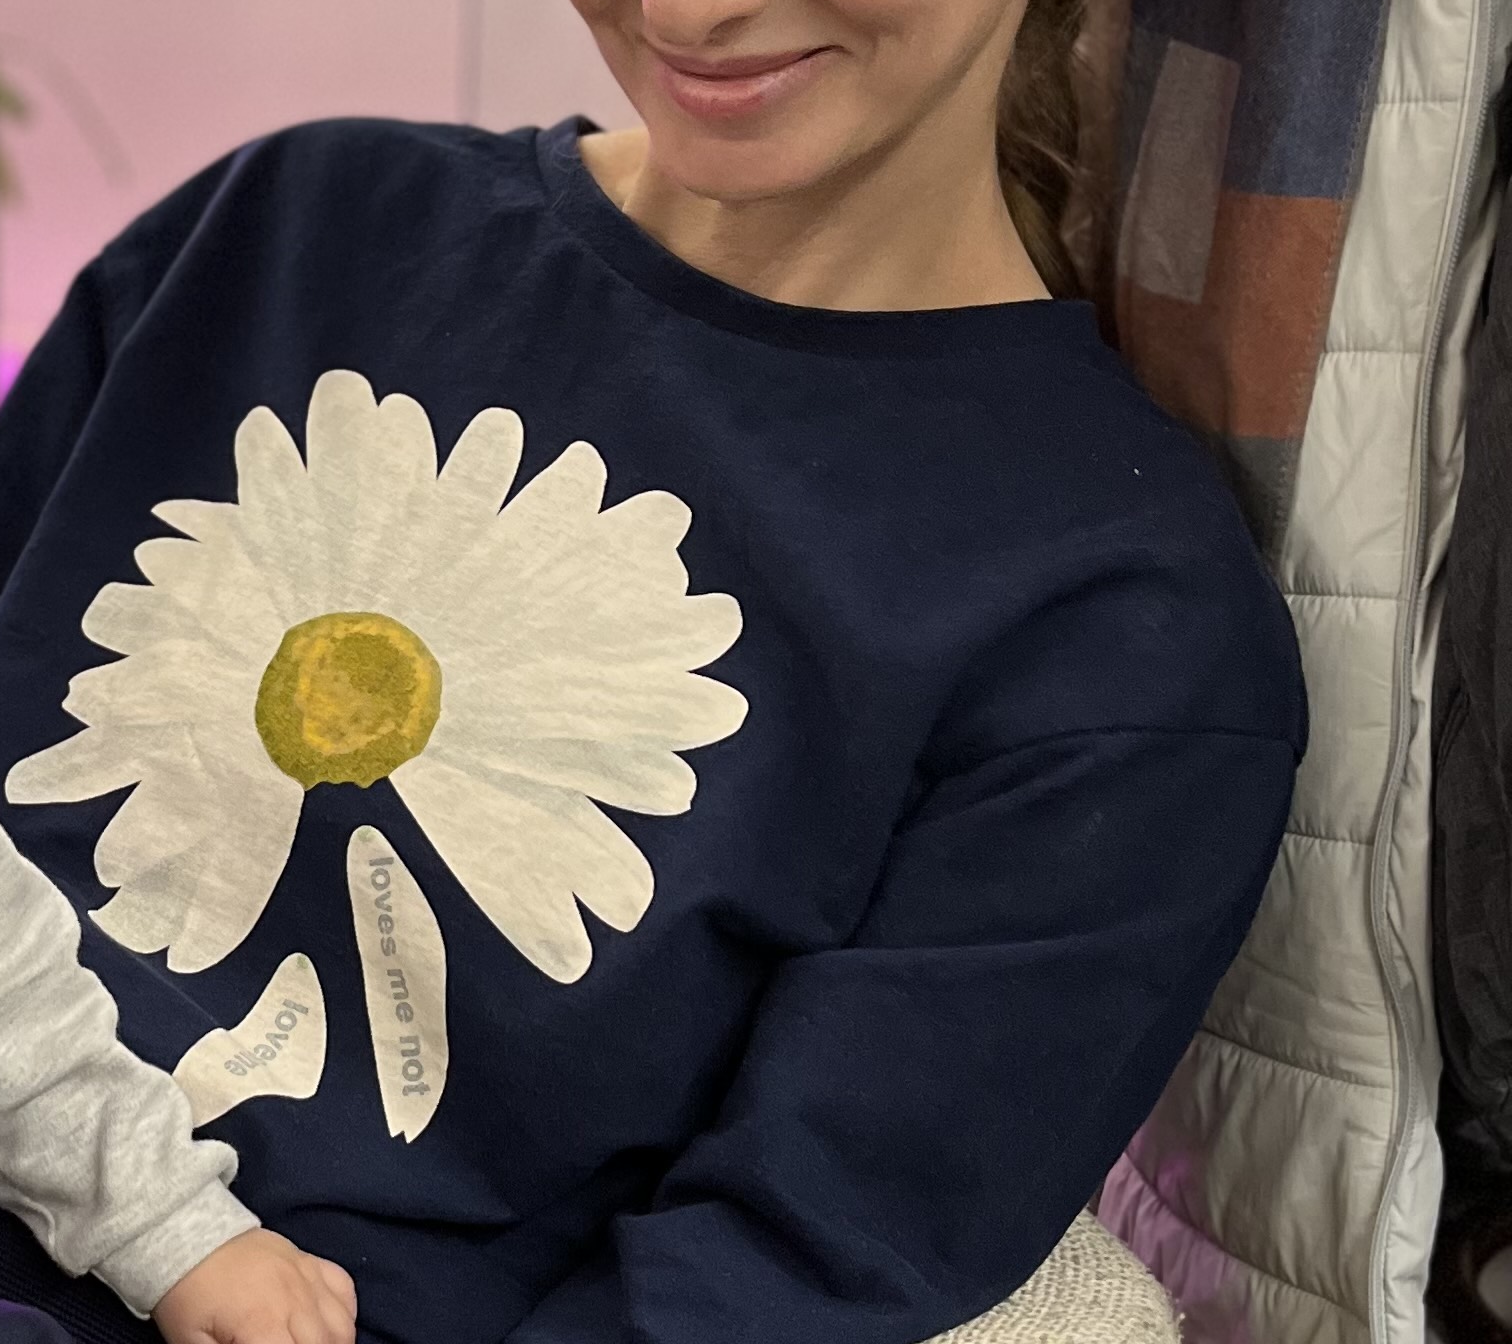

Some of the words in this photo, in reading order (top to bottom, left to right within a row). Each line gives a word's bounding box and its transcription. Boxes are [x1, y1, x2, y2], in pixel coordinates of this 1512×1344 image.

[368, 856, 397, 957] loves
[386, 968, 414, 1024] me
[252, 998, 310, 1063] love
[399, 1035, 431, 1097] not
